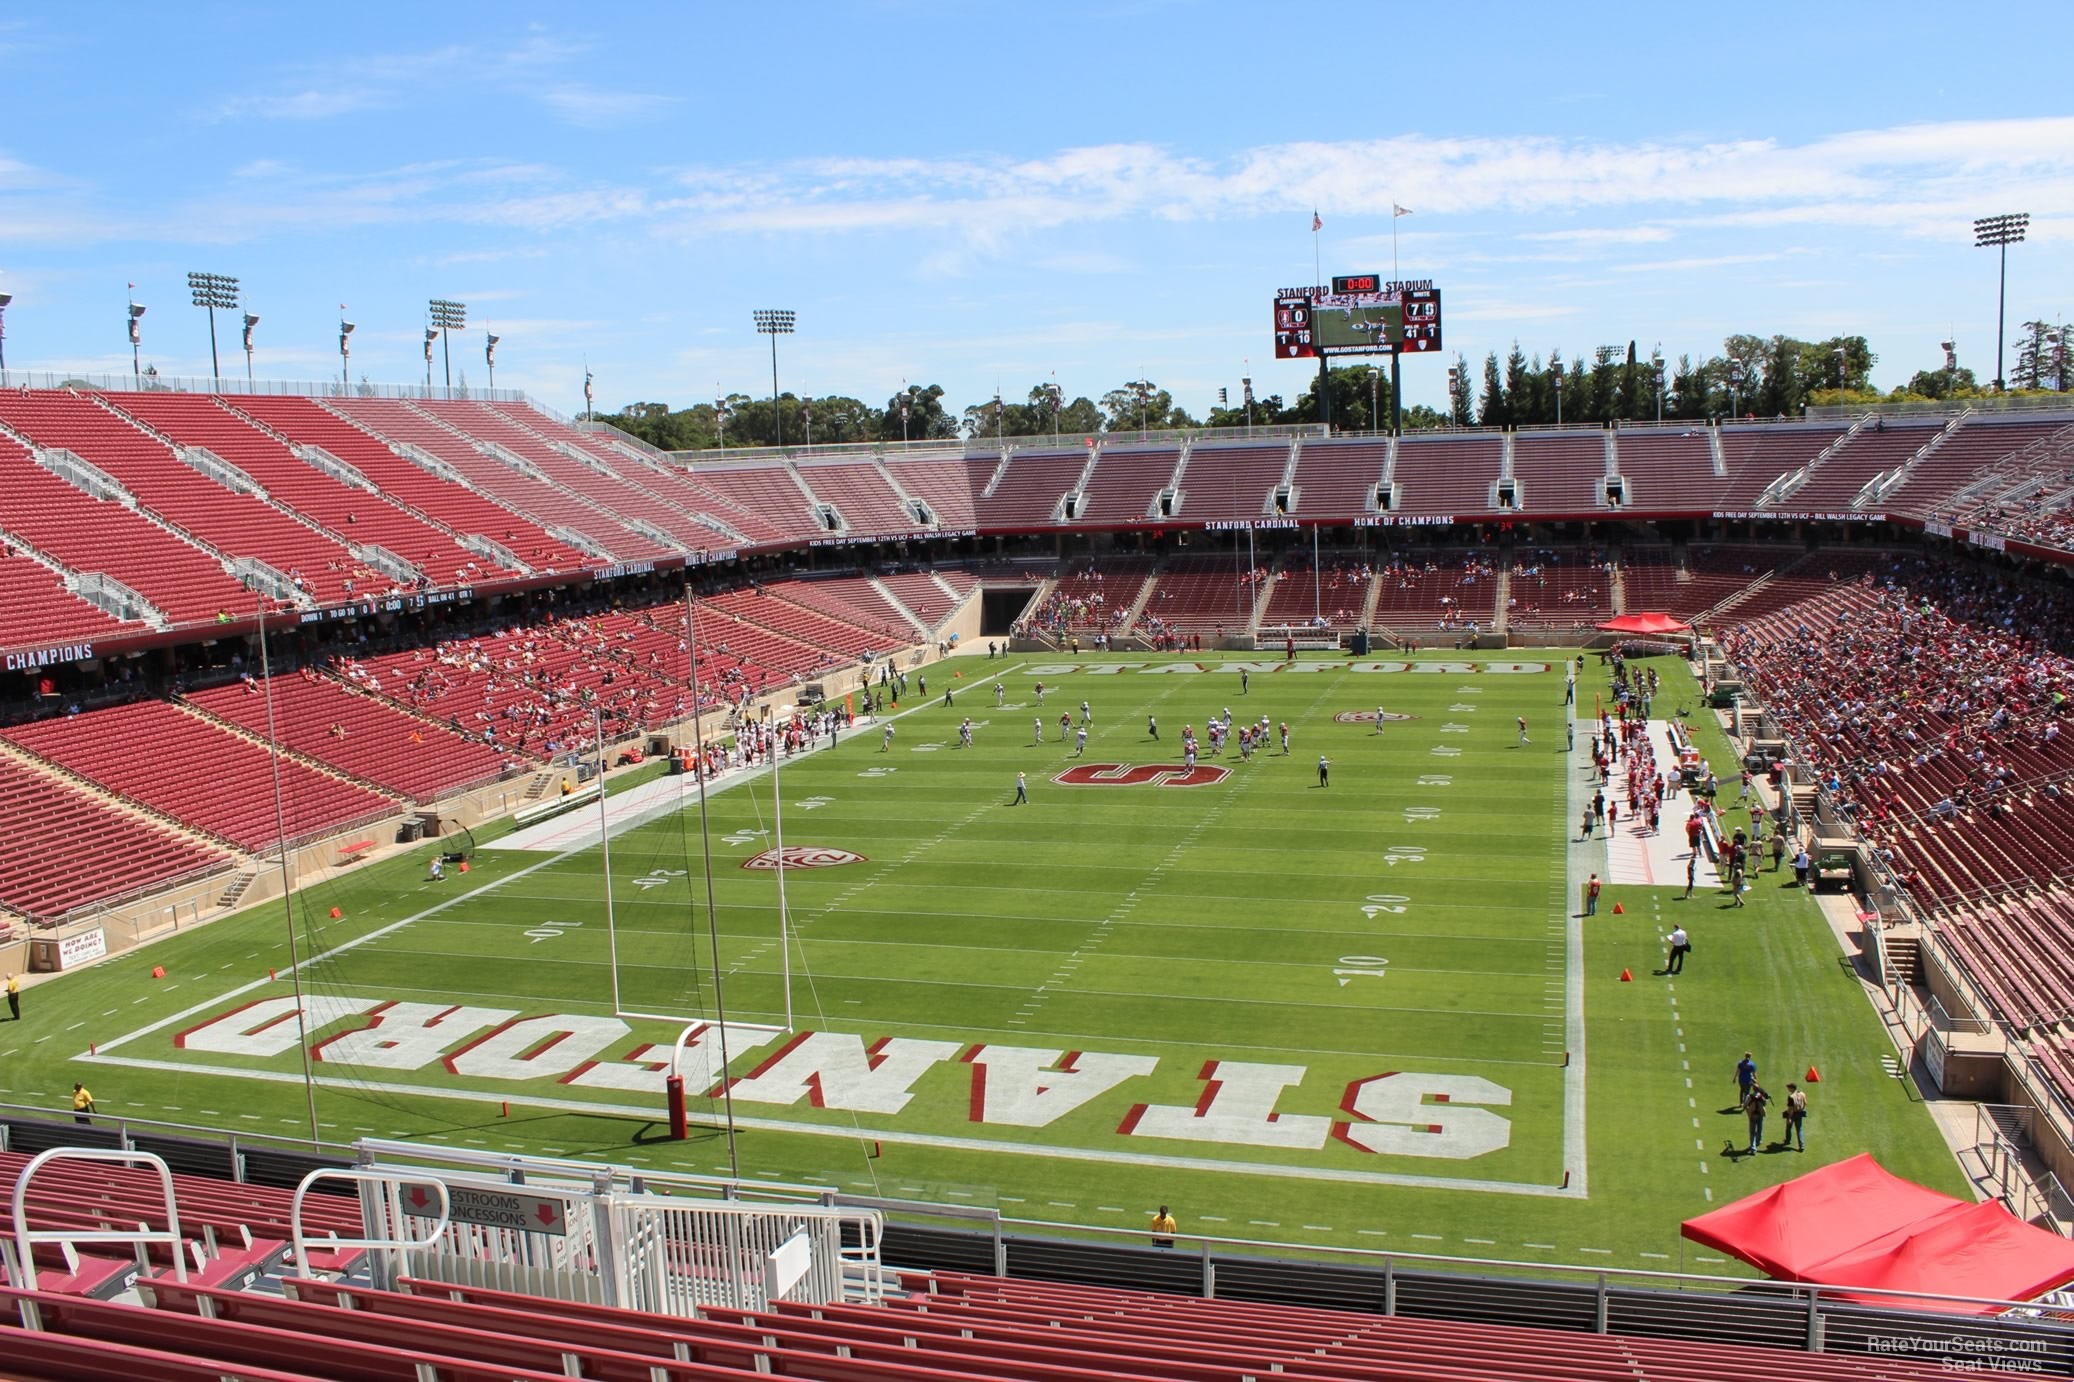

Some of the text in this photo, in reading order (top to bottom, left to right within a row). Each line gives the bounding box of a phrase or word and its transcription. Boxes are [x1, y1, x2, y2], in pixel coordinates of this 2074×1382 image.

[1347, 278, 1371, 289] 0:00
[1386, 279, 1432, 291] STADIUM
[1277, 286, 1329, 298] STANFORD
[1411, 303, 1419, 316] 7
[1295, 310, 1303, 322] 0
[1406, 329, 1417, 338] 41
[1429, 328, 1434, 337] 1
[1281, 335, 1286, 344] 1
[1298, 334, 1310, 344] 10
[1323, 345, 1393, 355] WWW.GOSTANFORD.COM
[1205, 519, 1300, 530] STANFORD CARDINAL
[1354, 515, 1454, 526] HOME OF CHAMPIONS
[847, 536, 876, 544] SEPTEMBER
[942, 530, 961, 538] LEGACY
[708, 550, 737, 563] CHAMPIONS
[594, 562, 655, 580] STANFORD CARDINAL
[428, 592, 455, 603] BALL ON 41
[459, 589, 473, 599] QTR 1
[362, 605, 368, 613] 0
[386, 599, 401, 611] 0:00
[301, 611, 323, 622] DOWN 1
[330, 608, 355, 618] TO GO 10
[6, 643, 93, 670] CHAMPIONS
[1023, 661, 1551, 675] STANFORD
[1417, 774, 1453, 785] 50
[1402, 807, 1442, 819] 40
[721, 829, 770, 843] 30
[1384, 846, 1428, 861] 30
[632, 869, 688, 885] 20
[1361, 894, 1411, 913] 20
[523, 921, 583, 938] 10
[65, 932, 98, 948] HOW ARE
[63, 938, 102, 956] WE DOING?
[1333, 956, 1389, 977] 10
[176, 995, 1512, 1159] STANFORD
[447, 1190, 520, 1210] ESTROOMS
[446, 1205, 527, 1226] ONCESSIONS
